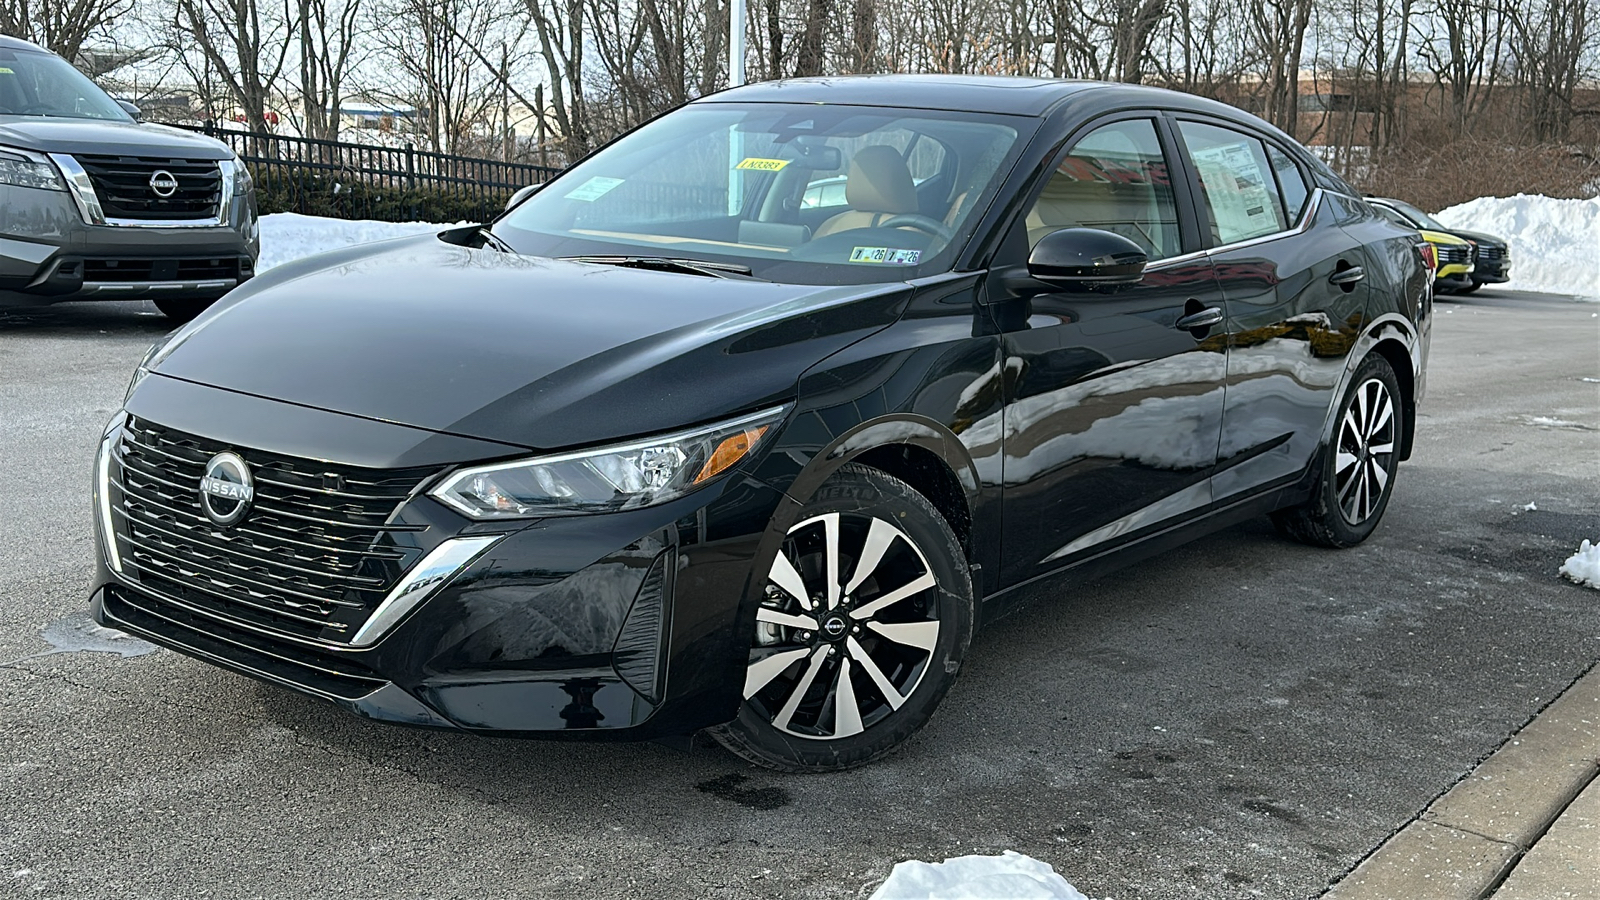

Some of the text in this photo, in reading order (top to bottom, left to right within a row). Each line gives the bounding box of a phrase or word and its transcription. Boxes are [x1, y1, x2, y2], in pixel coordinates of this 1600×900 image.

[874, 249, 885, 260] 26
[907, 251, 919, 263] 26
[200, 477, 250, 499] NISSAN
